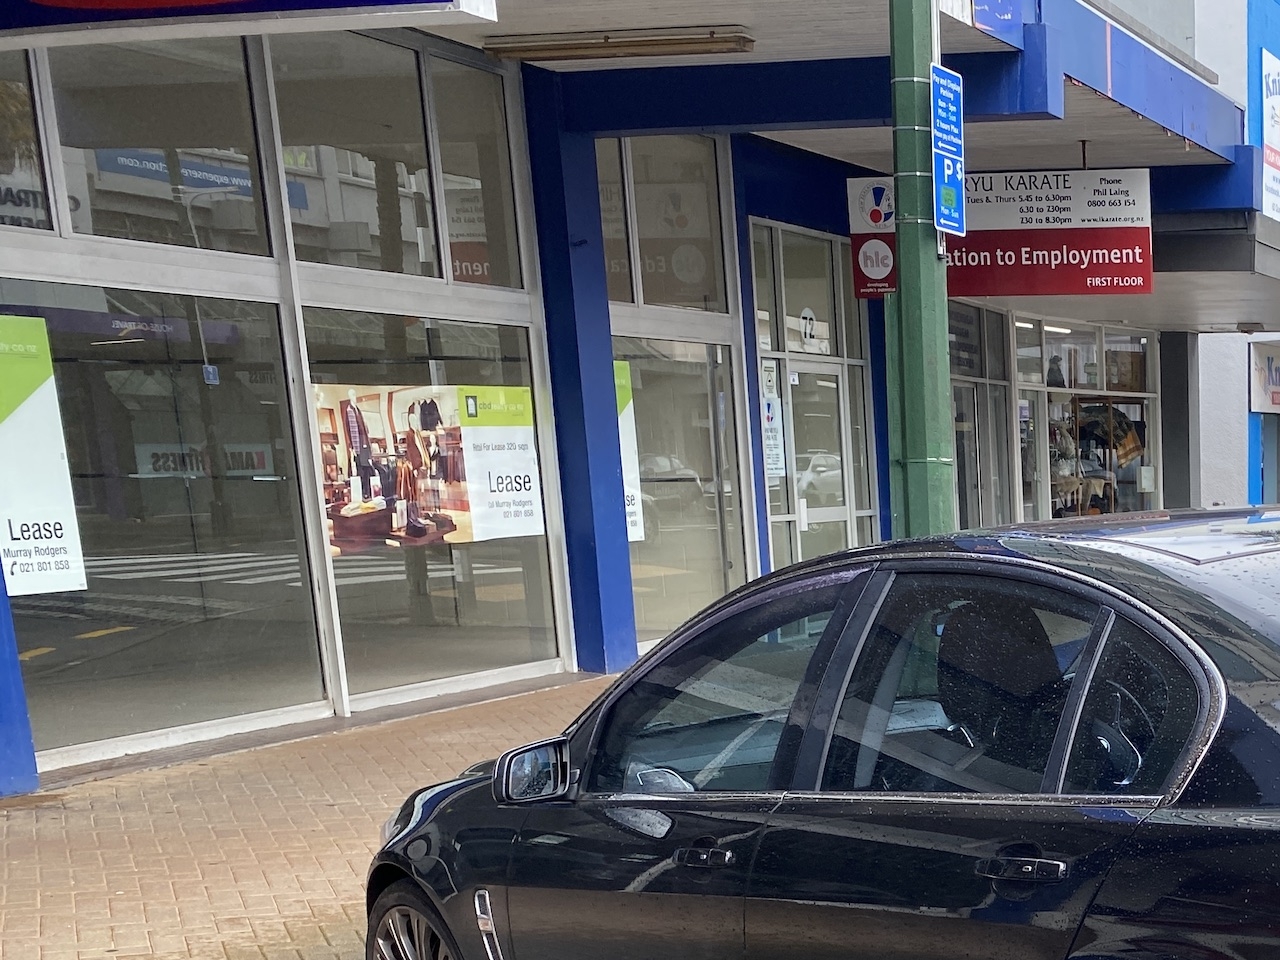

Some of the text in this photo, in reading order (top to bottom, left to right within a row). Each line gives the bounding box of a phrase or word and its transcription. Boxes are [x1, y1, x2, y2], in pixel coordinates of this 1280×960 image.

[940, 86, 954, 101] Parking
[944, 158, 954, 183] P
[1004, 174, 1072, 191] KARATE
[1100, 177, 1122, 185] Phone
[967, 196, 984, 204] Tues
[1045, 193, 1072, 203] 6.30pm
[1093, 188, 1130, 197] Phil Laing
[1087, 199, 1136, 207] 0800 663 154
[863, 251, 890, 268] hlc
[996, 248, 1016, 266] to
[1020, 245, 1143, 269] Employment
[1087, 277, 1144, 287] FIRST FLOOR
[802, 316, 815, 339] 72
[483, 443, 491, 451] For
[491, 443, 506, 451] Lease
[506, 442, 517, 450] 320
[488, 471, 532, 493] Lease
[495, 500, 512, 509] Murray
[512, 499, 533, 508] Rodgers
[503, 510, 512, 518] 021
[8, 518, 64, 541] Lease
[3, 545, 68, 559] Murray Rodgers
[19, 560, 70, 573] 021 801 858
